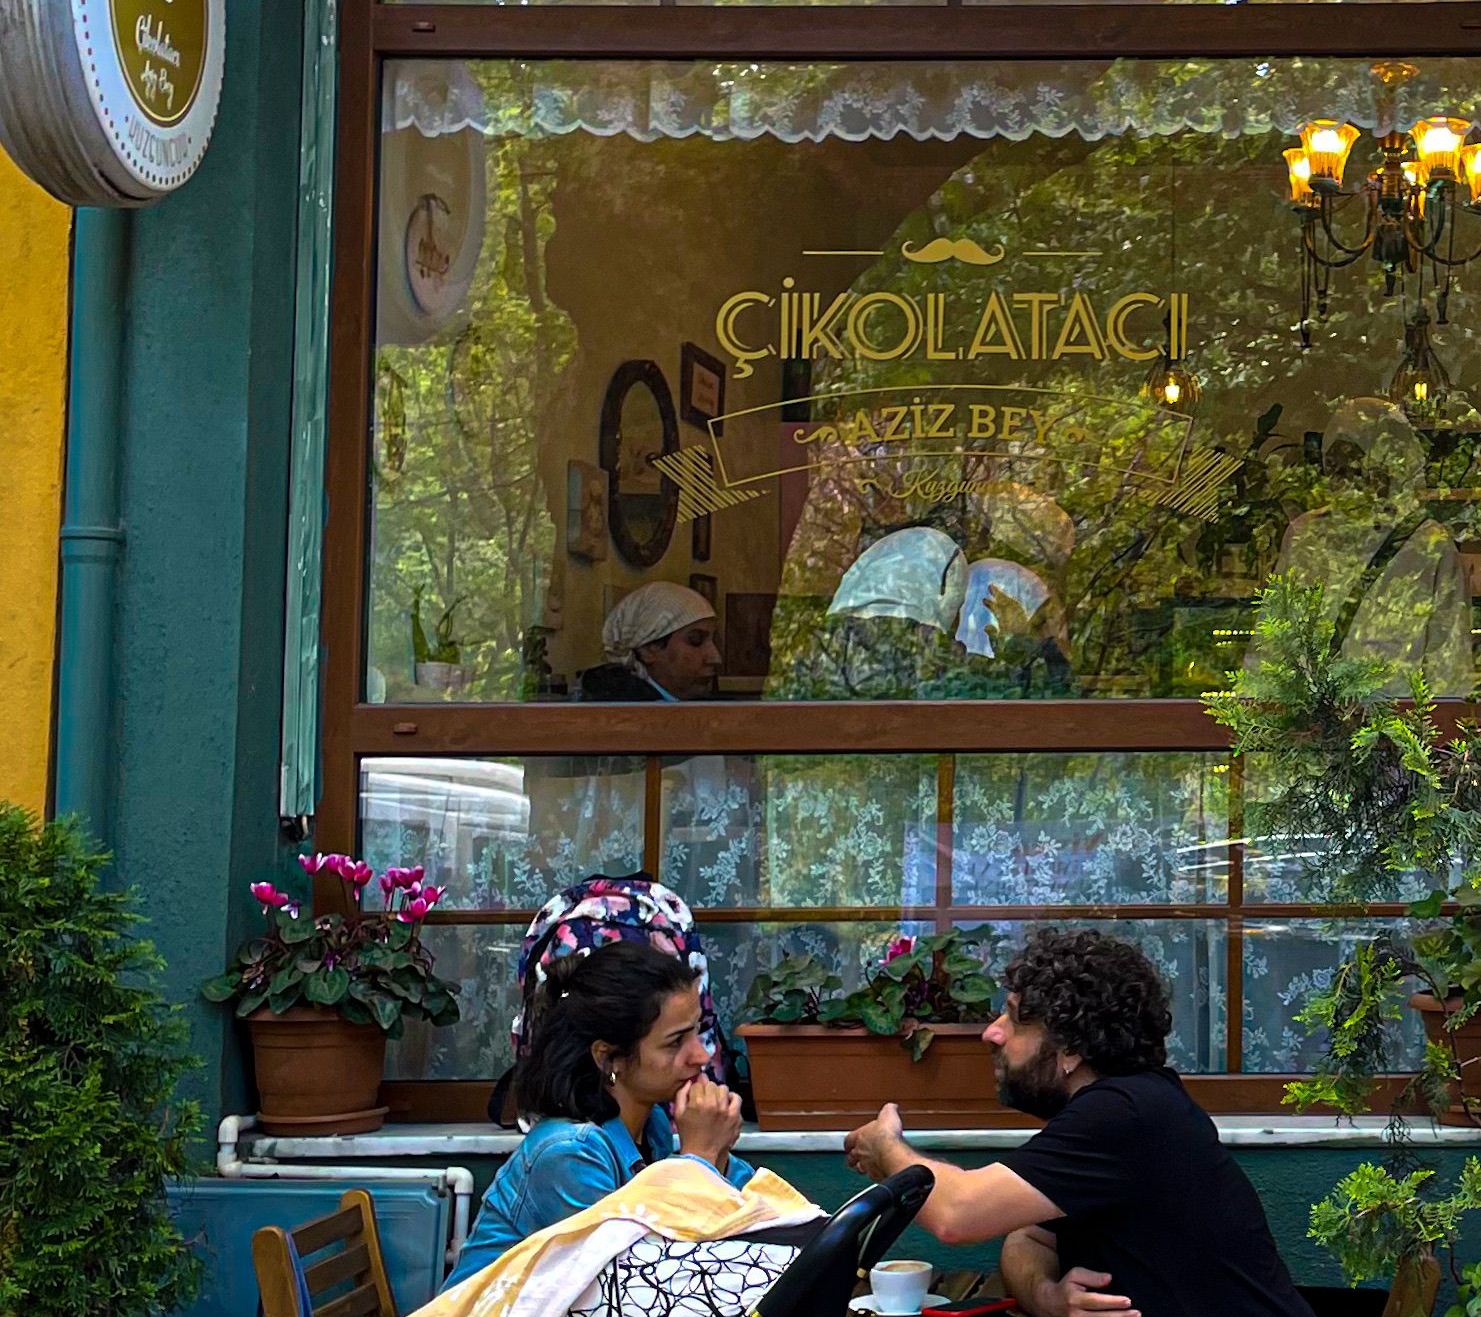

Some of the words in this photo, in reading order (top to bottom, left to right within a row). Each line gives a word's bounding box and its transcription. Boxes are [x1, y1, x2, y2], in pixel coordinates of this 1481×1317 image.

[715, 277, 1190, 379] ÇİKOLATACI
[851, 398, 956, 446] AZİZ
[971, 403, 1058, 446] BEY
